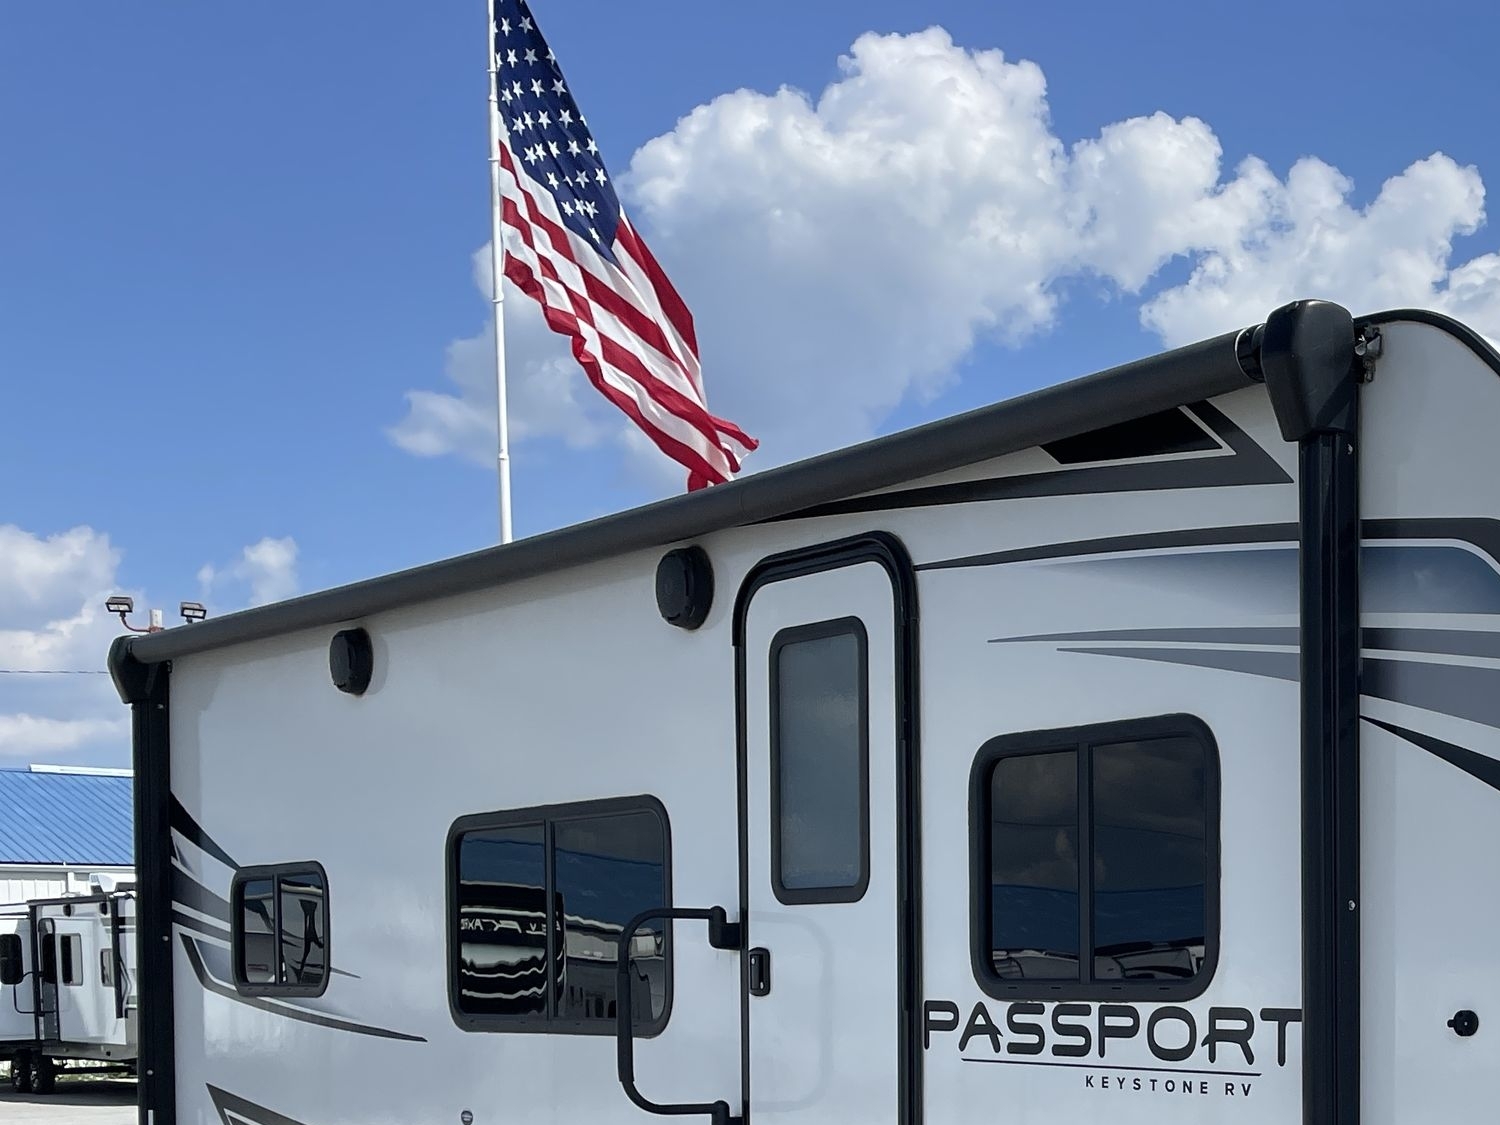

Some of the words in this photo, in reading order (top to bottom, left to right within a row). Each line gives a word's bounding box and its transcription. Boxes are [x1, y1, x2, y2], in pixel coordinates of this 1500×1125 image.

[924, 1000, 1303, 1067] PASSPORT
[1085, 1075, 1209, 1095] KEYSTONE
[1224, 1082, 1252, 1097] RV
